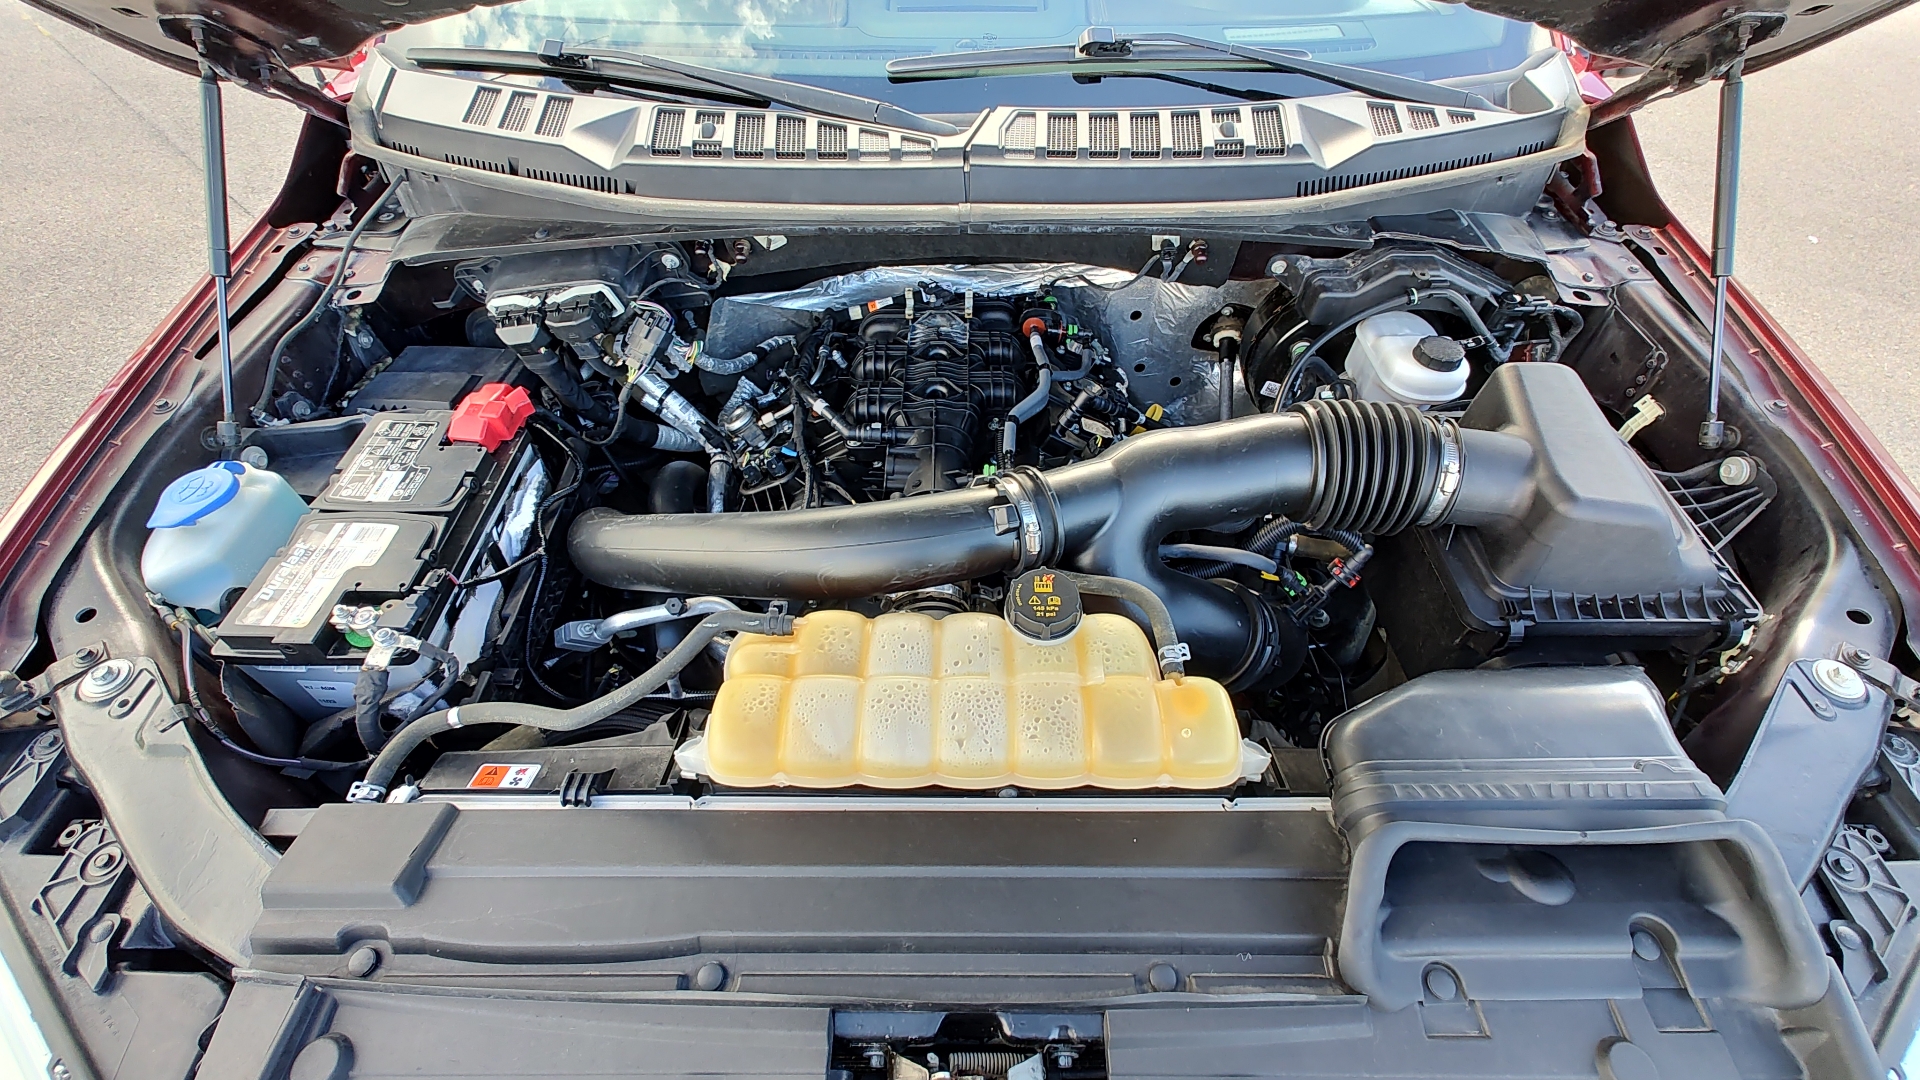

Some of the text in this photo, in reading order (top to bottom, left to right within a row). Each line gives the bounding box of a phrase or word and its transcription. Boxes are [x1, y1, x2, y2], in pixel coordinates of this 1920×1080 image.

[253, 540, 311, 602] Duralast
[283, 544, 318, 586] PLATINUM
[294, 544, 327, 590] TECHNOLOGY
